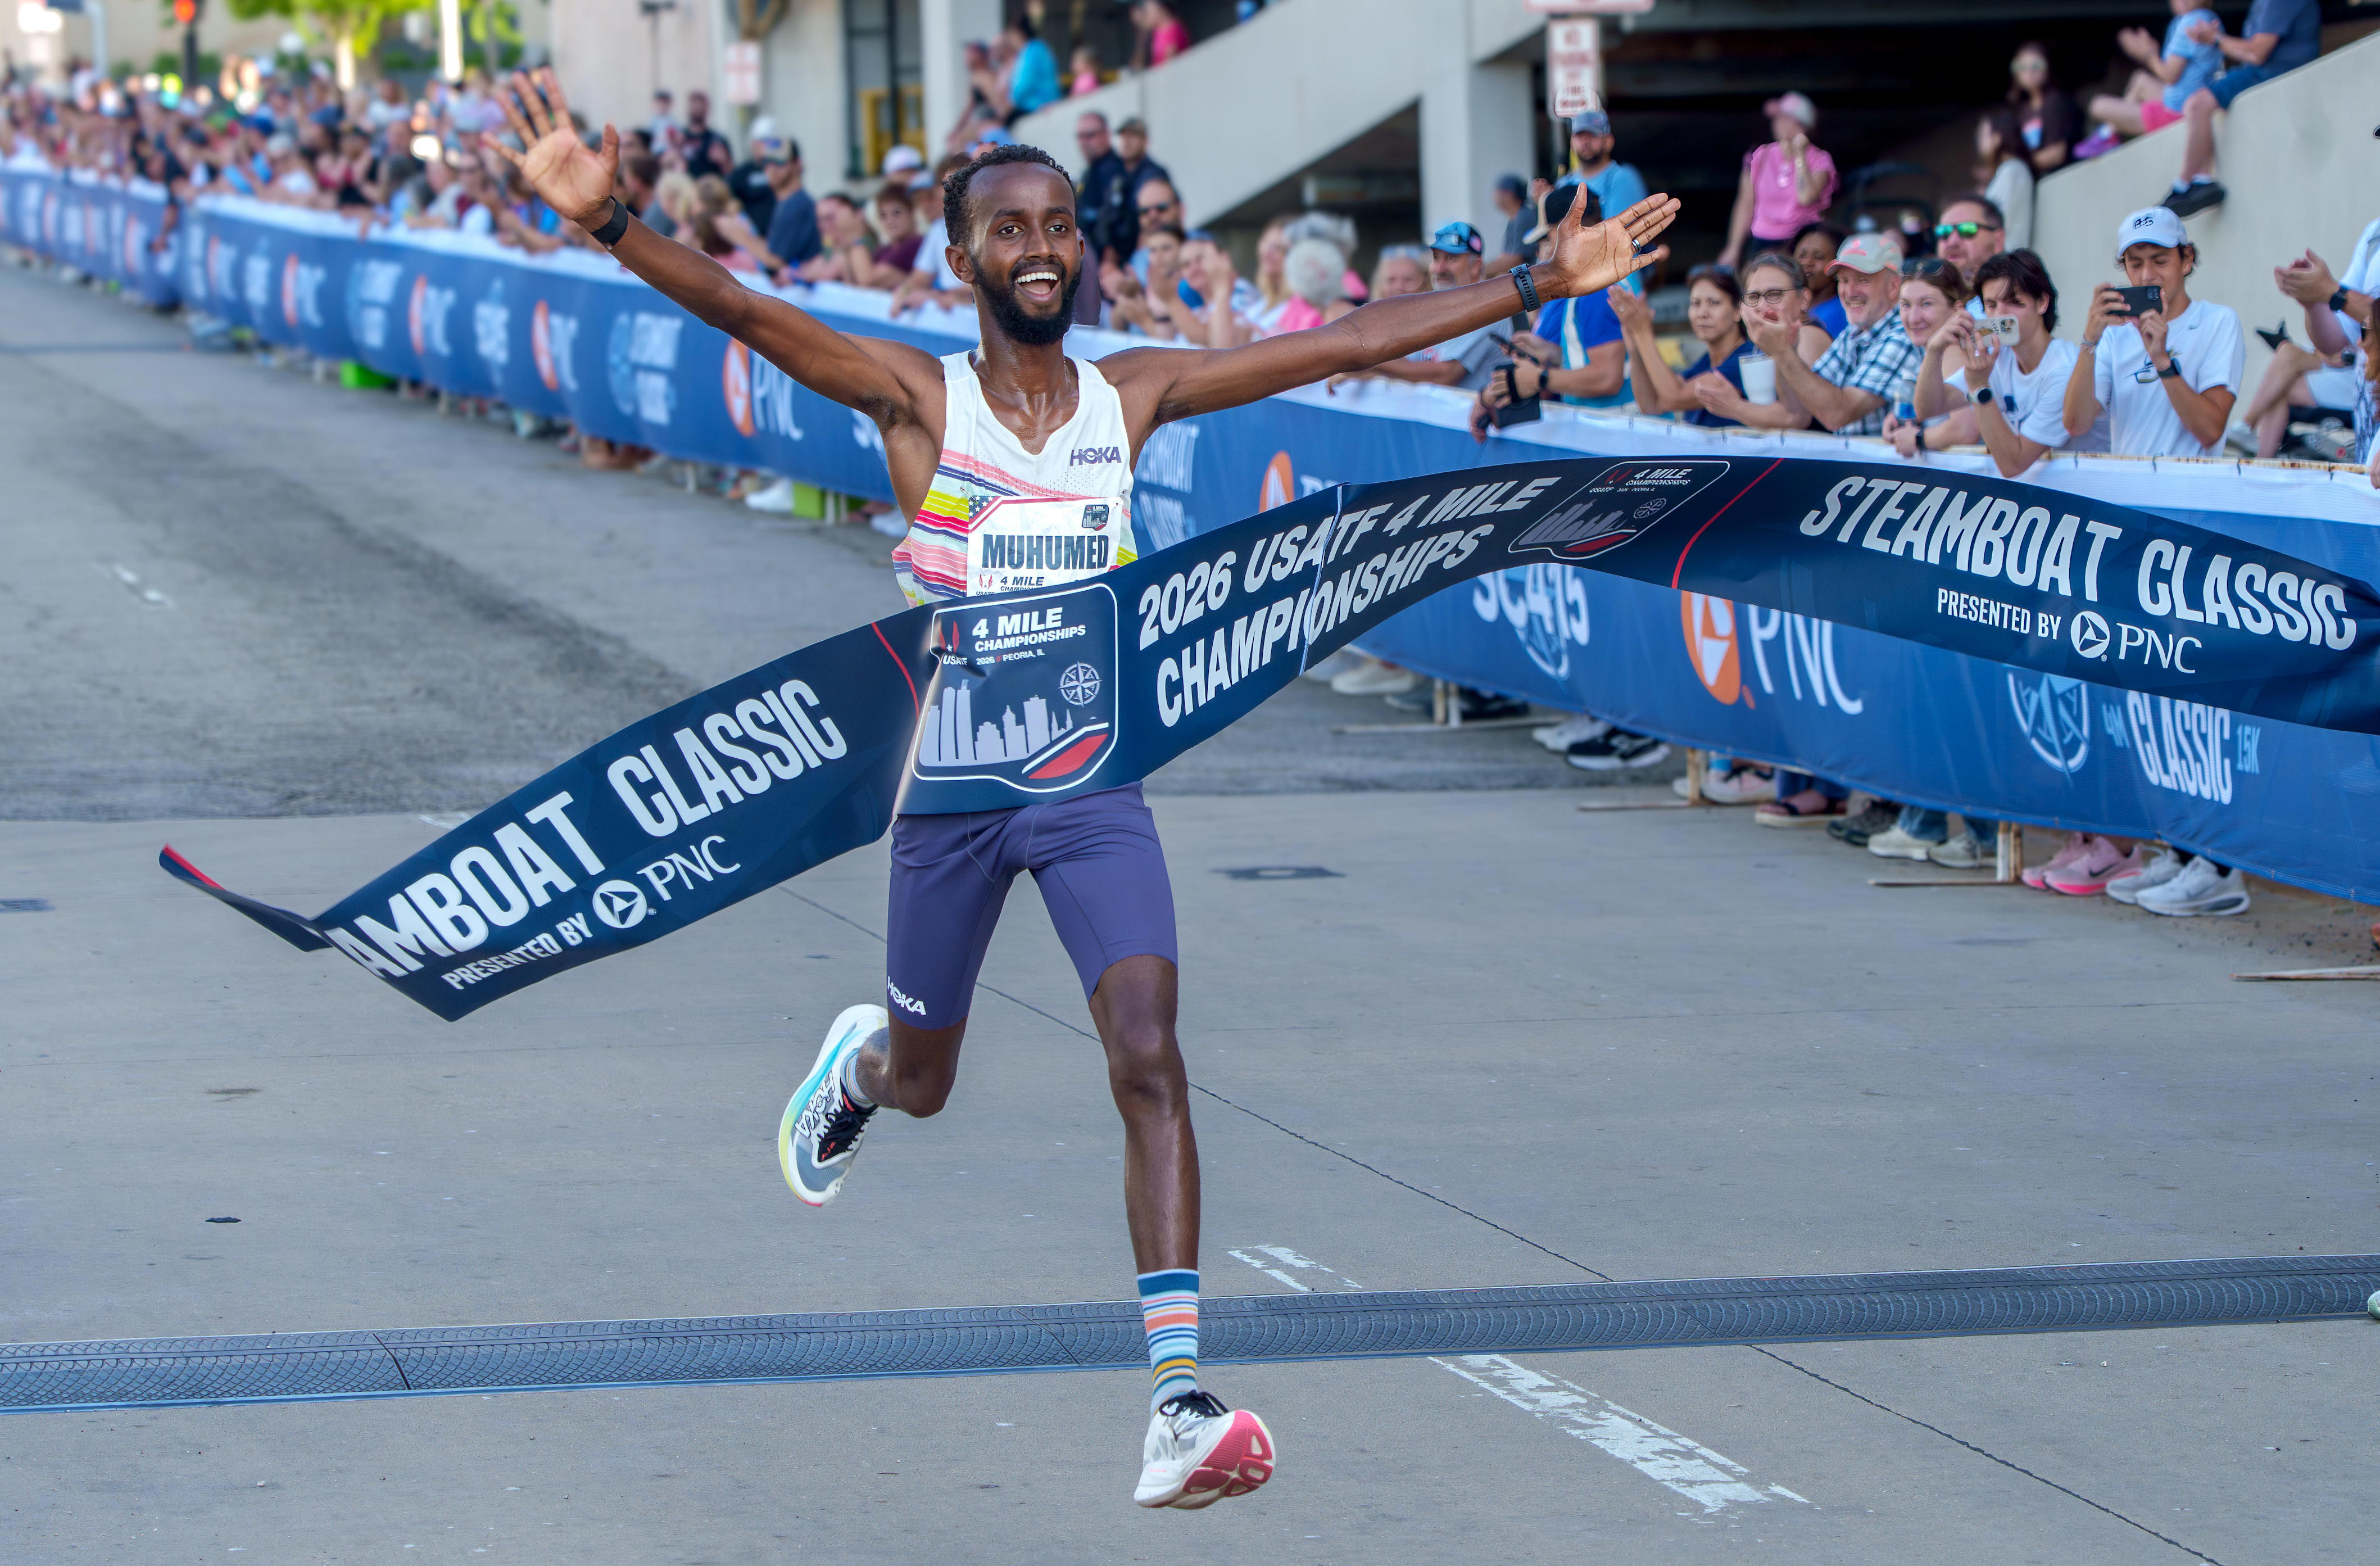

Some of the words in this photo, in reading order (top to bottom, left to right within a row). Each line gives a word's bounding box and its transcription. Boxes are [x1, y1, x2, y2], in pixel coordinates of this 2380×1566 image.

[1070, 447, 1122, 467] HOKA
[1634, 469, 1651, 479] 4
[1646, 469, 1693, 478] MILE
[982, 535, 1109, 570] MUHUMED
[1139, 551, 1235, 650] 2026
[1244, 503, 1393, 593] USATF
[1384, 495, 1430, 536] 4
[1417, 477, 1562, 528] MILE
[1800, 476, 2122, 601] STEAMBOAT
[2138, 538, 2356, 650] CLASSIC
[1000, 576, 1008, 585] 4
[1012, 577, 1044, 586] MILE
[972, 619, 989, 639] 4
[997, 607, 1063, 636] MILE
[974, 625, 1086, 652] CHAMPIONSHIPS
[1157, 524, 1494, 727] CHAMPIONSHIPS
[1938, 588, 2030, 634] PRESENTED
[2038, 613, 2061, 640] BY
[2116, 622, 2202, 673] PNC
[1003, 650, 1036, 662] PEORIA,
[608, 680, 847, 836] CLASSIC
[2127, 690, 2232, 805] CLASSIC
[2237, 723, 2261, 775] 15K
[441, 933, 563, 990] PRESENTED
[556, 912, 593, 947] BY
[637, 836, 741, 901] PNC
[887, 976, 926, 1015] HOKA
